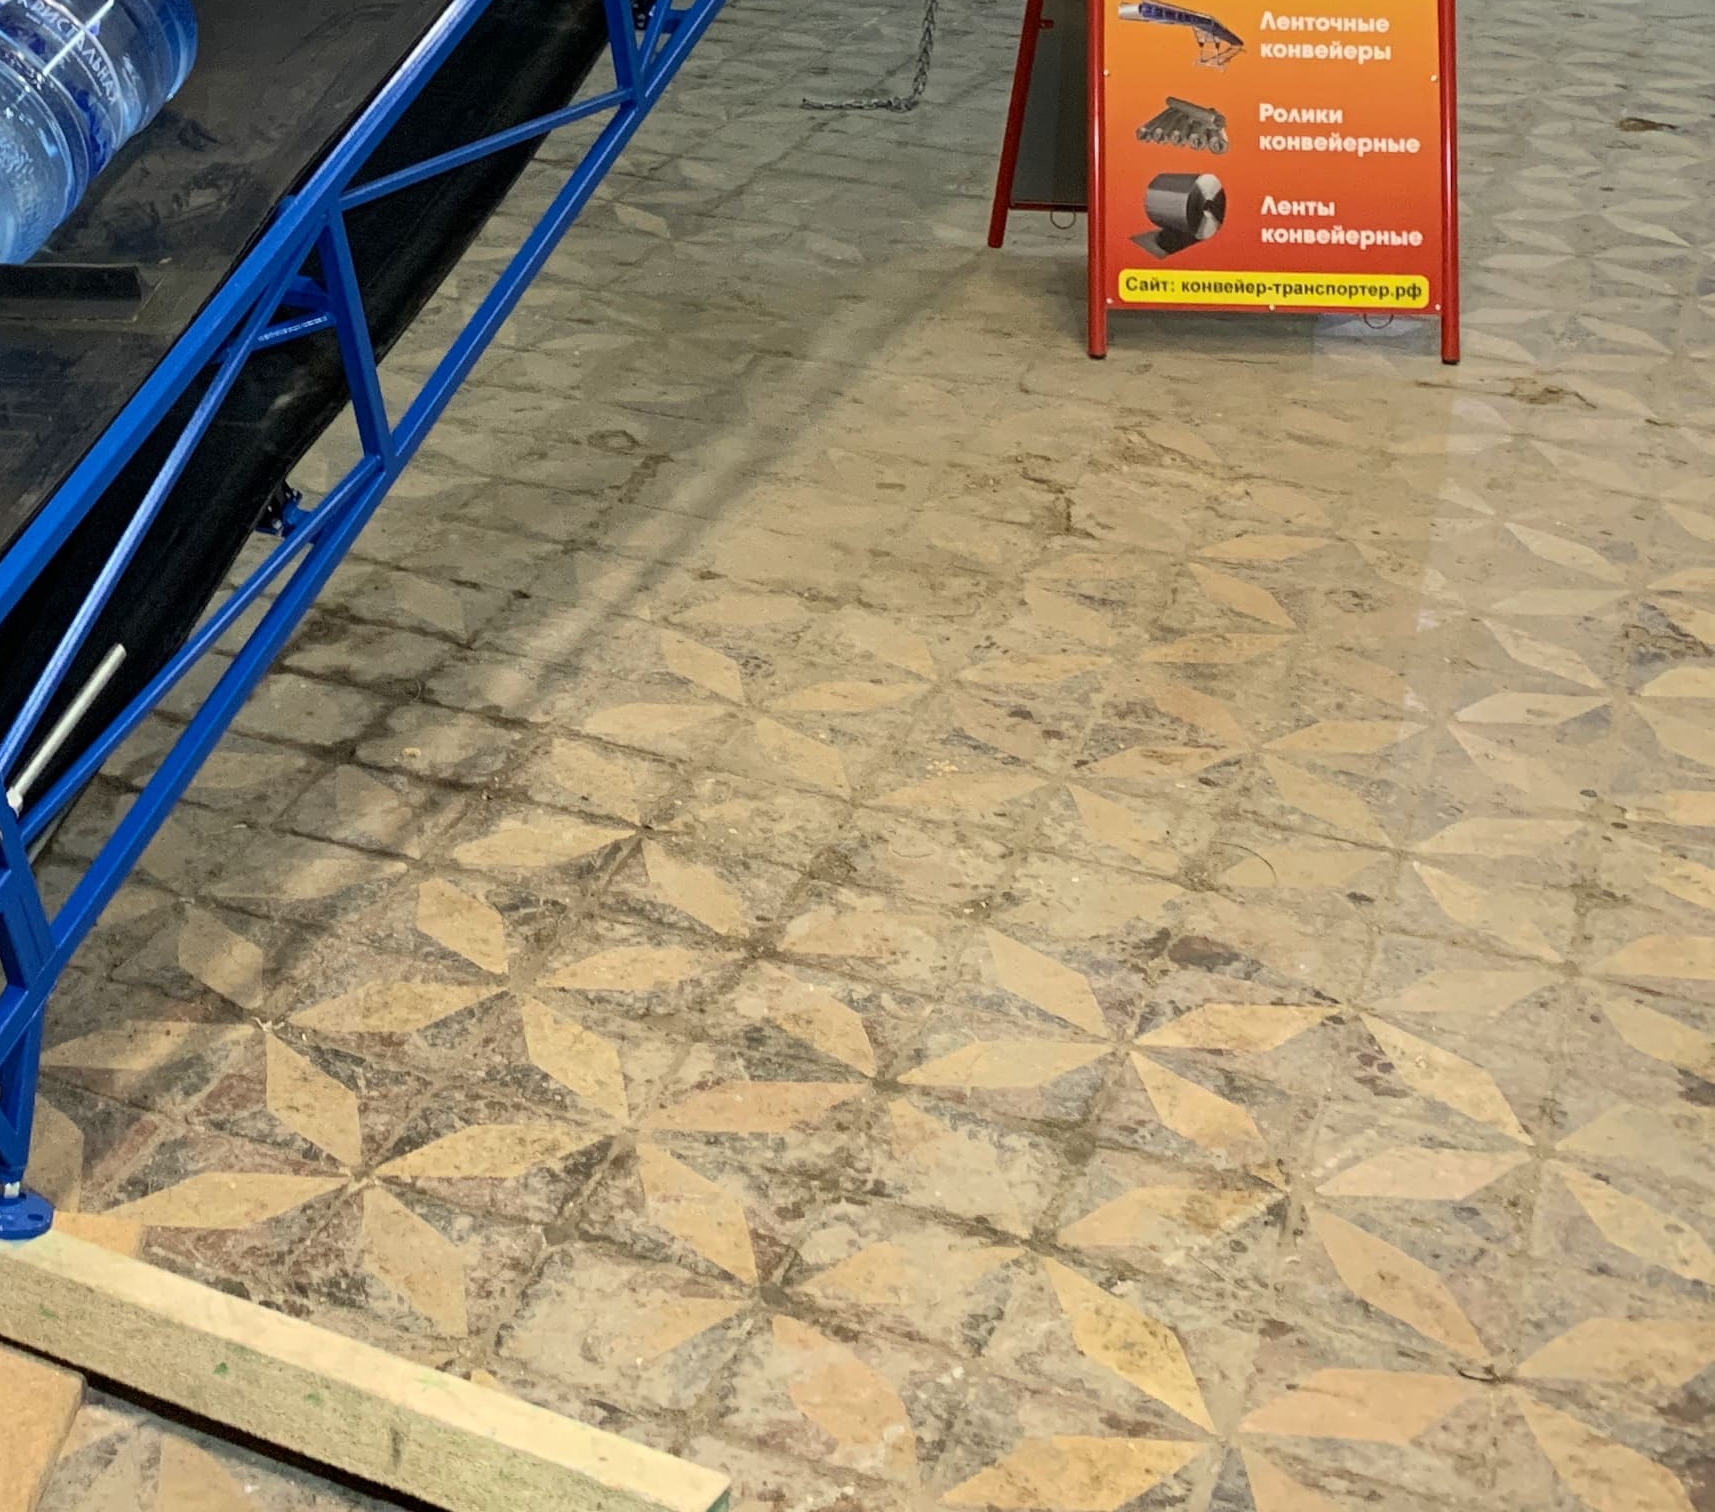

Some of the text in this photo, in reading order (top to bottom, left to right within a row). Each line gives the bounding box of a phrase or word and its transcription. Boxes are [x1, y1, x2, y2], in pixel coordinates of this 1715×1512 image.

[1259, 10, 1391, 34] Ленточные
[1259, 40, 1392, 64] конвейеры
[1258, 103, 1343, 125] Ролики
[1258, 133, 1421, 157] конвейерные
[1260, 195, 1335, 218] Ленты
[1260, 225, 1423, 250] конвейерные
[1125, 276, 1422, 301] Сайт: конвейер-транспортер.рф
